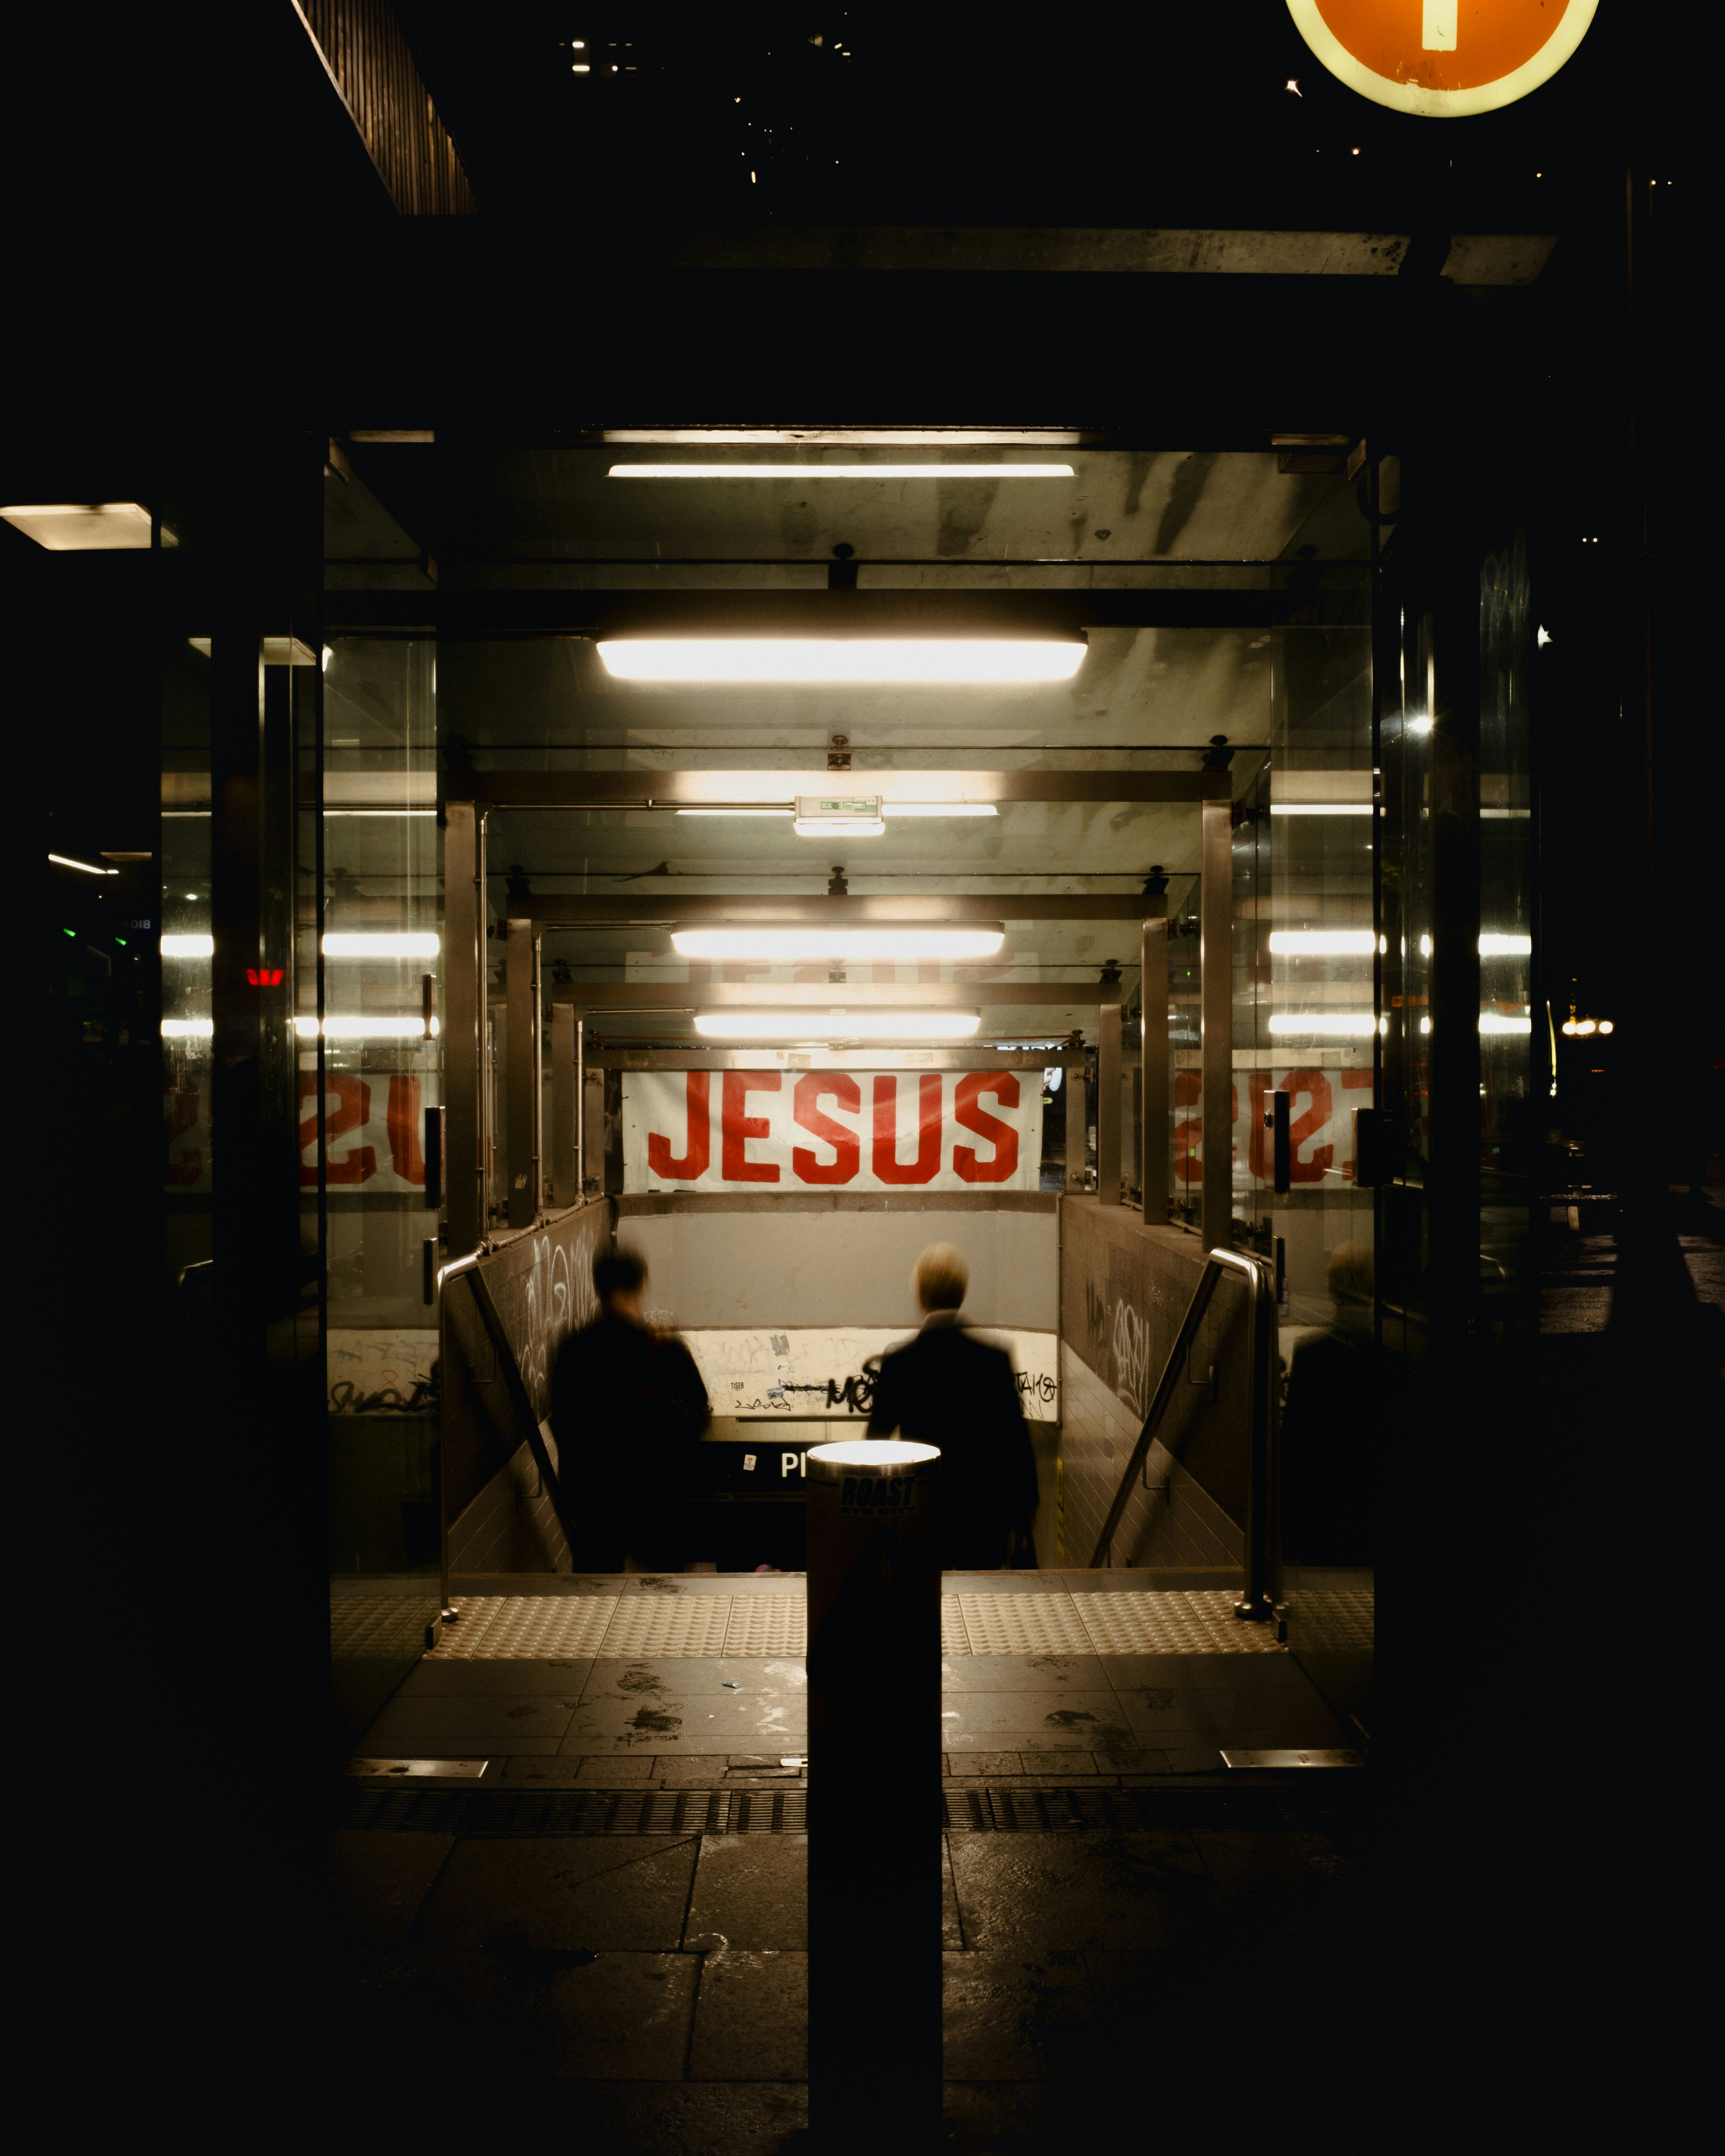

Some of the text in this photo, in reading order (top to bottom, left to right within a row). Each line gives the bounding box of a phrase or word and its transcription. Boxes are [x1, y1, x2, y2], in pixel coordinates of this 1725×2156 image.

[648, 1071, 1020, 1184] JESUS
[841, 1477, 916, 1507] ROAST
[878, 1506, 916, 1515] CITY
